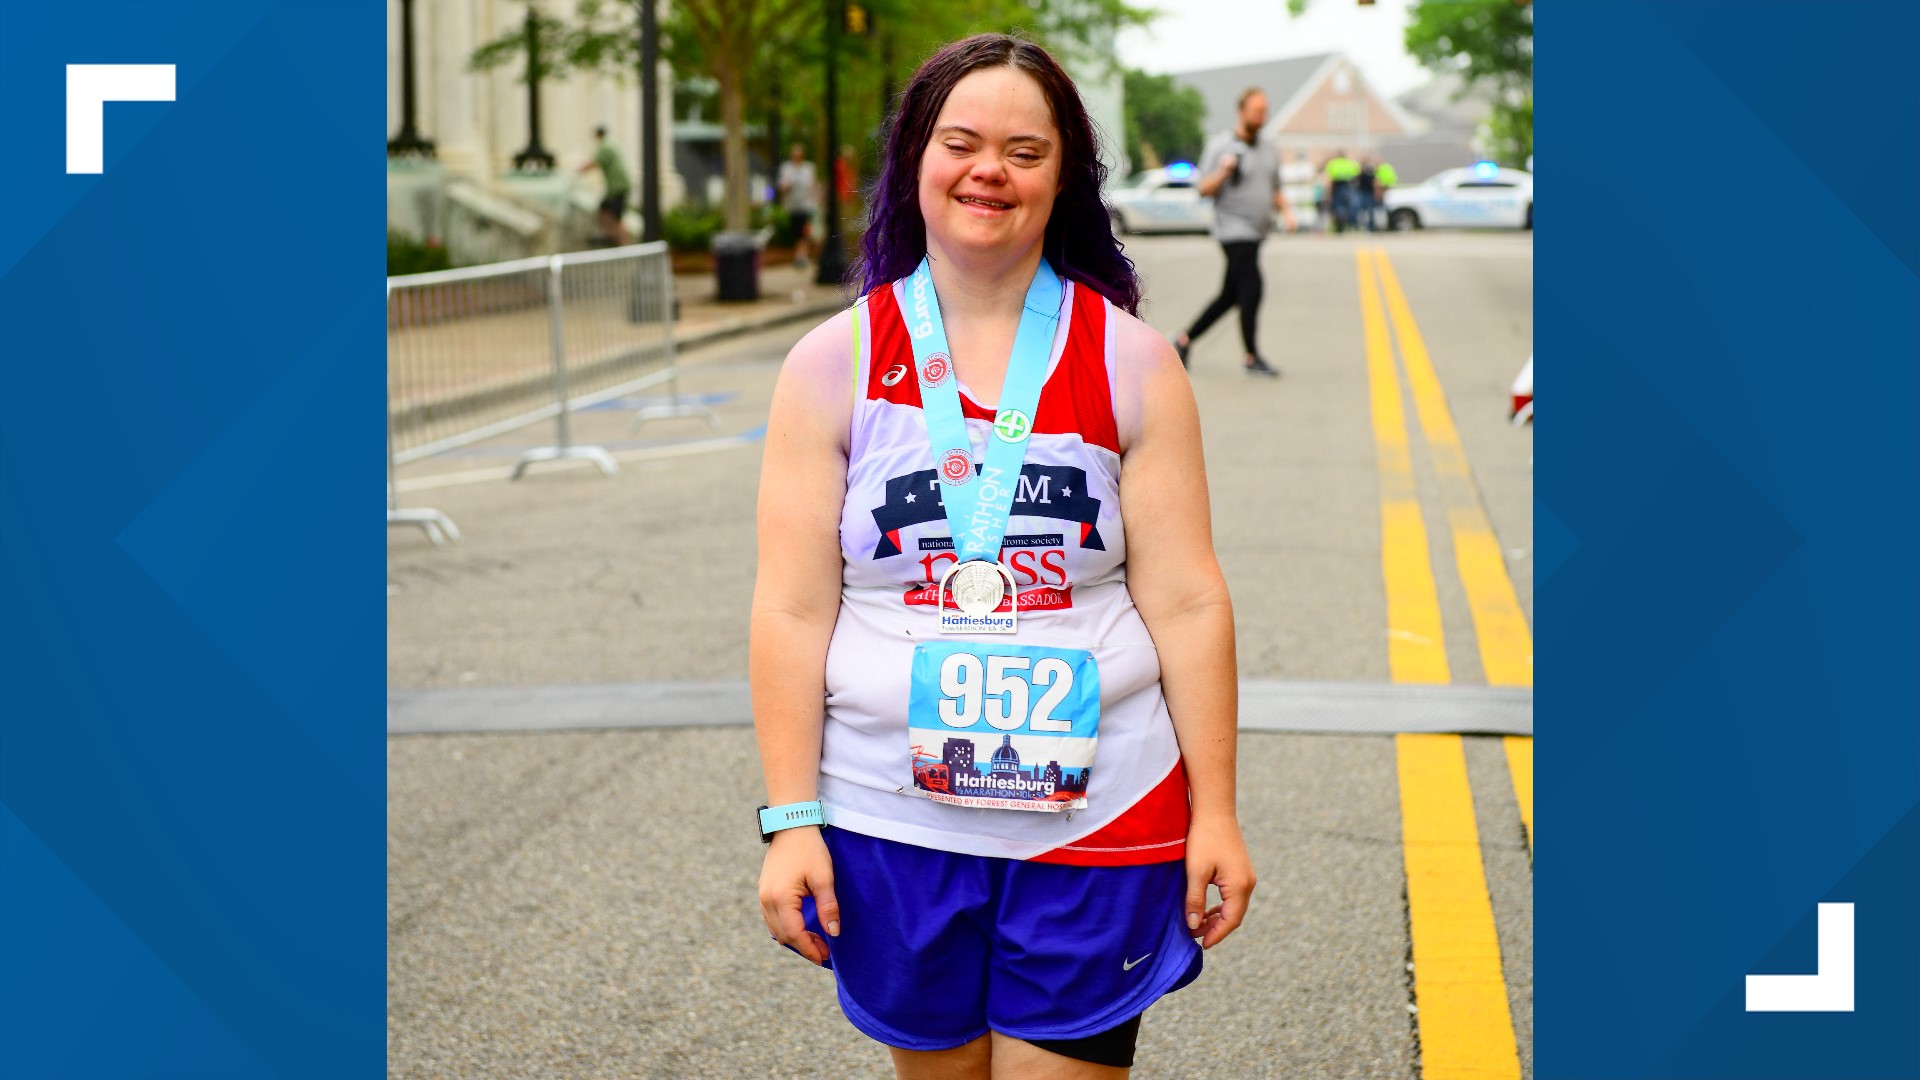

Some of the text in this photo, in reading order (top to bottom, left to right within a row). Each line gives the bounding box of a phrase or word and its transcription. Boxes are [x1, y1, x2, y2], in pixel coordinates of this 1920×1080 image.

[965, 466, 1005, 553] RATHON
[984, 488, 1012, 554] ISHER
[921, 539, 955, 549] nationa
[1030, 535, 1061, 547] society
[942, 615, 1013, 628] Hattiesburg
[937, 652, 1074, 733] 952
[955, 772, 1055, 796] Hattiesburg
[926, 792, 962, 805] PRESENTED
[976, 799, 1008, 807] FORREST
[1009, 801, 1045, 810] GENERAL
